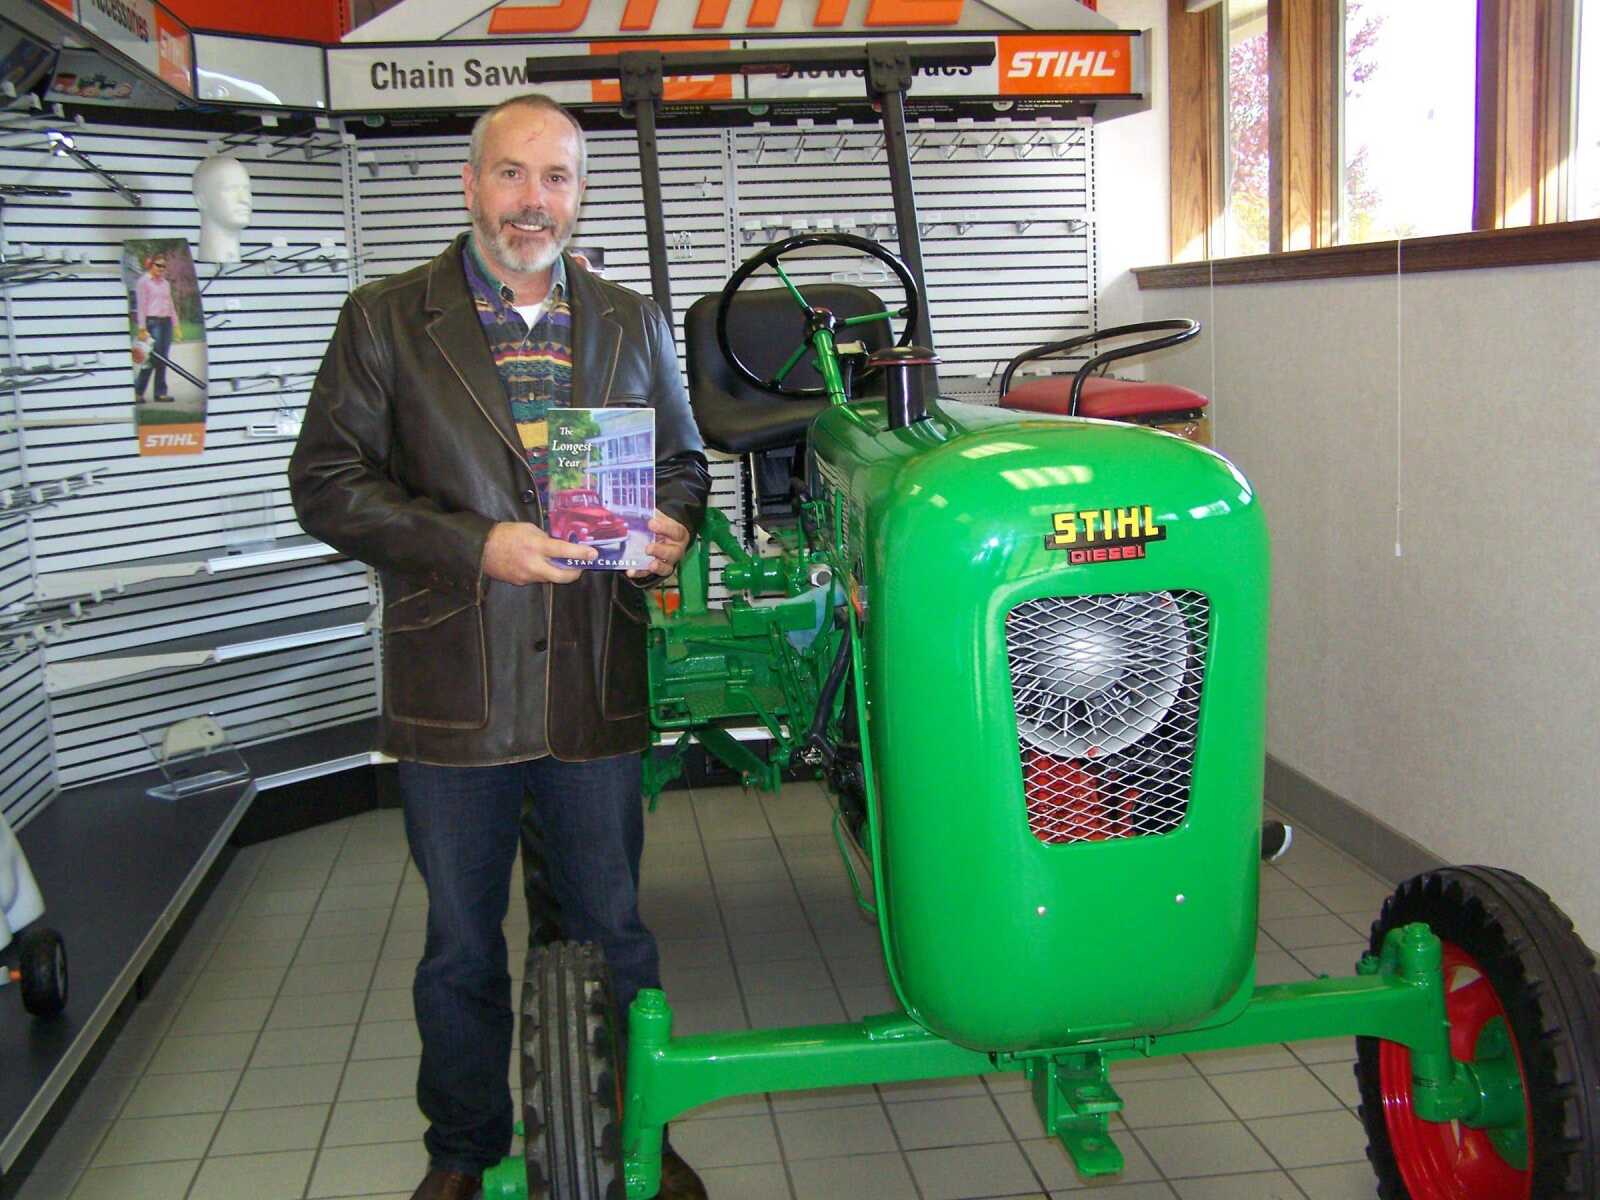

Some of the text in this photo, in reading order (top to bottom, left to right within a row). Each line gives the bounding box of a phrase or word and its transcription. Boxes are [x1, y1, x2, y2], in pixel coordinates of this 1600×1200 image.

[1007, 51, 1116, 78] STIHL
[370, 59, 540, 90] Chain Saw
[559, 426, 574, 436] The
[145, 432, 199, 448] STIHL
[552, 440, 592, 454] Longest
[558, 457, 581, 468] Year
[1053, 505, 1159, 544] STIHL
[1070, 546, 1145, 564] DIESEL
